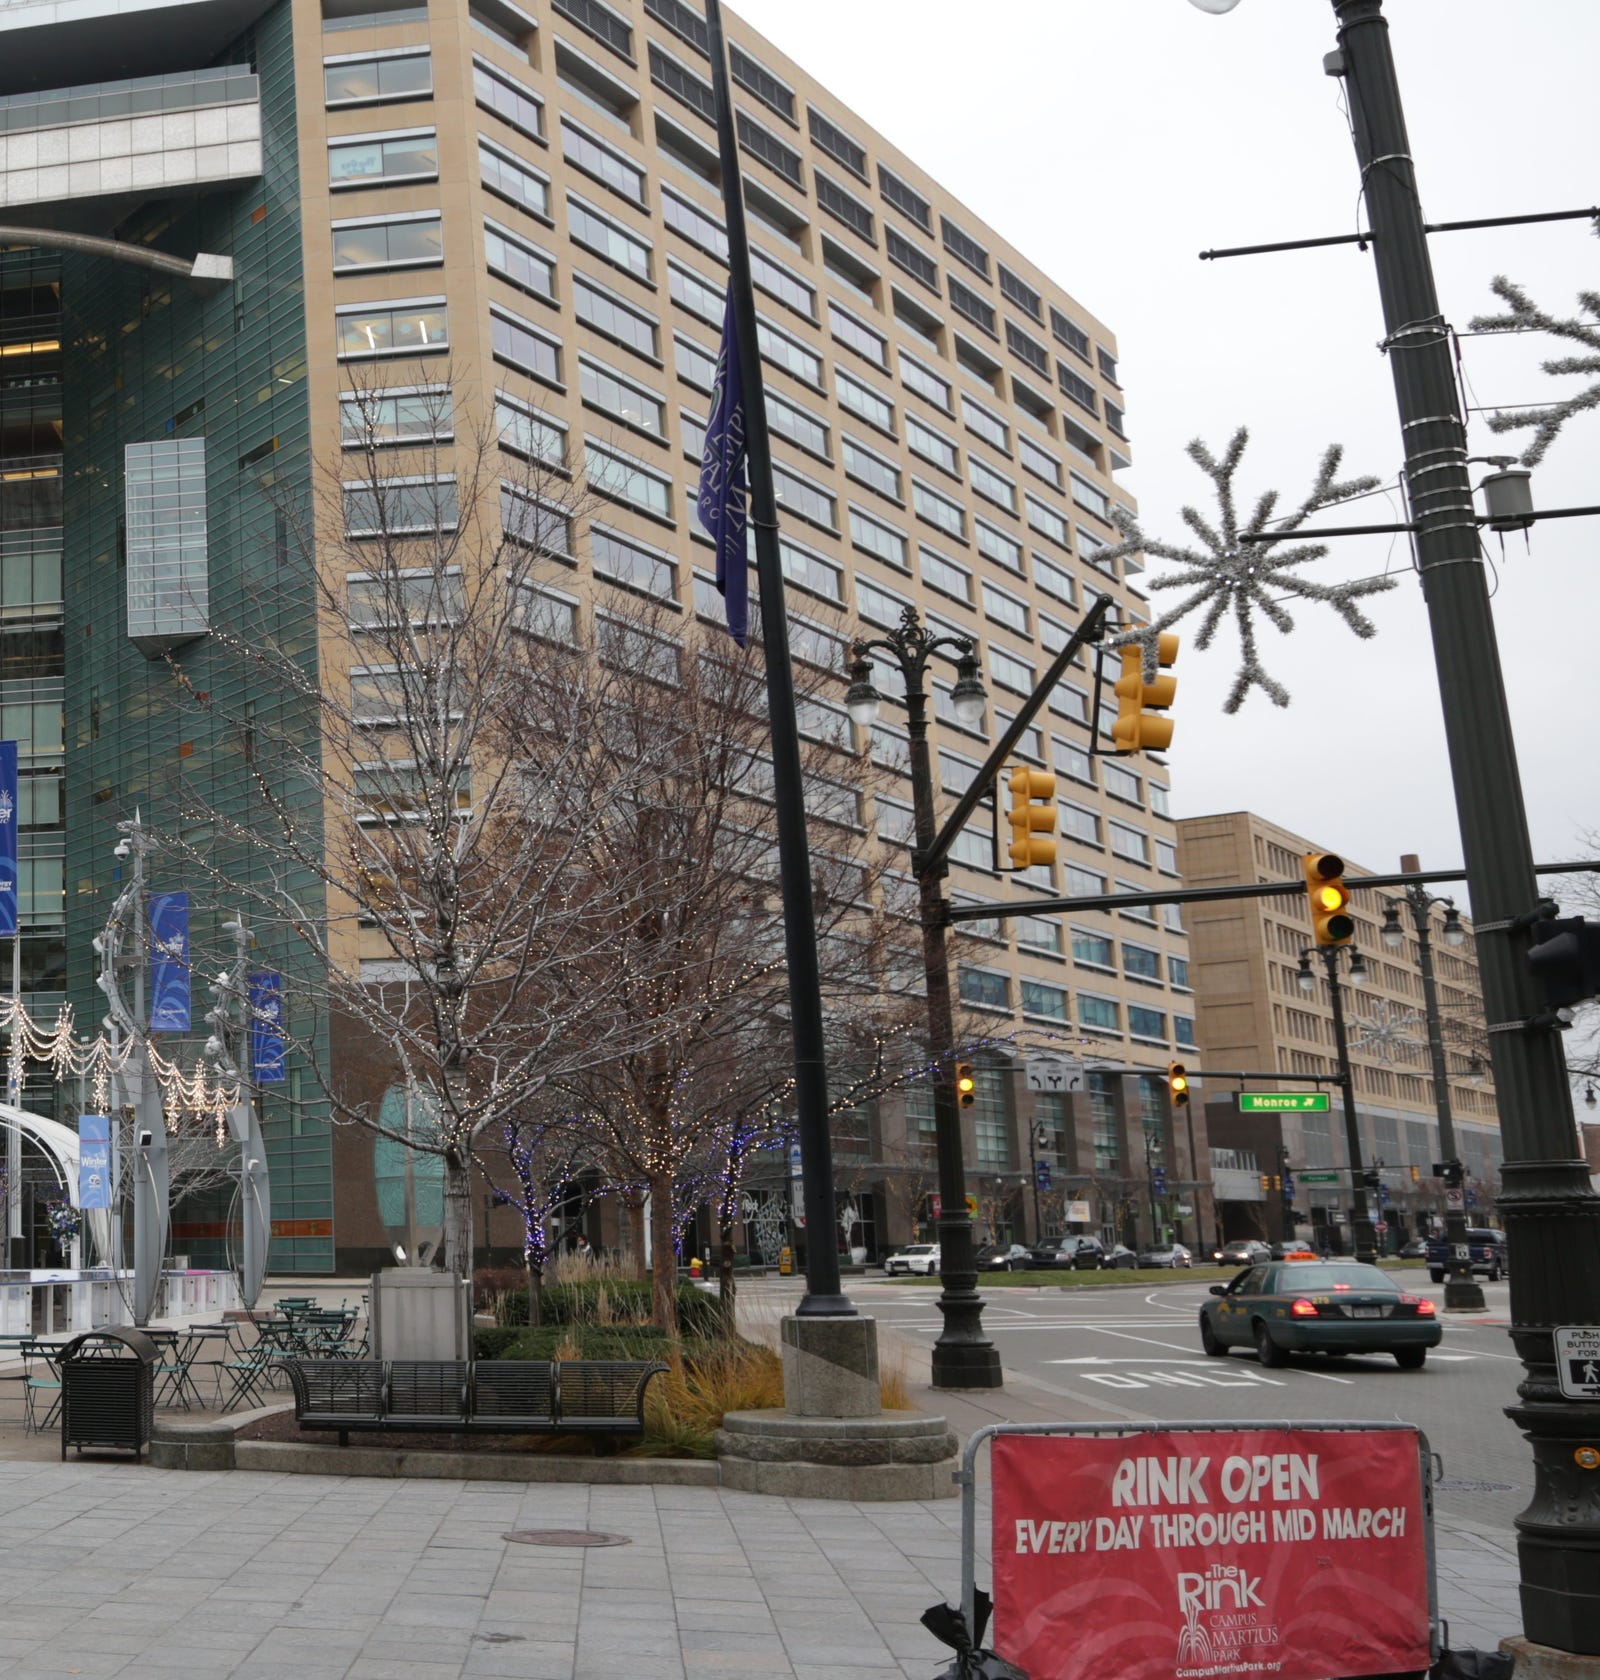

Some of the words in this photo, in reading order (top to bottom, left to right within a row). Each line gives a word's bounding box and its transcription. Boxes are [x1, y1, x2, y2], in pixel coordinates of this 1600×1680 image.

[1252, 1097, 1298, 1107] Monroe
[1571, 1331, 1600, 1340] PUSH
[1567, 1341, 1600, 1349] BUTTO
[1080, 1369, 1288, 1388] ONLY
[1112, 1456, 1211, 1507] RINK
[1220, 1453, 1320, 1503] OPEN
[1015, 1518, 1092, 1554] EVERY
[1095, 1515, 1144, 1551] DAY
[1150, 1511, 1267, 1548] THROUGH
[1273, 1508, 1317, 1541] MID
[1322, 1506, 1407, 1540] MARCH
[1210, 1563, 1238, 1578] The
[1177, 1568, 1266, 1613] Rink
[1209, 1612, 1257, 1629] CAMPUS
[1212, 1626, 1279, 1647] MARTIUS
[1213, 1648, 1241, 1662] PARK
[1175, 1661, 1282, 1679] CampusMartiusPark.org
